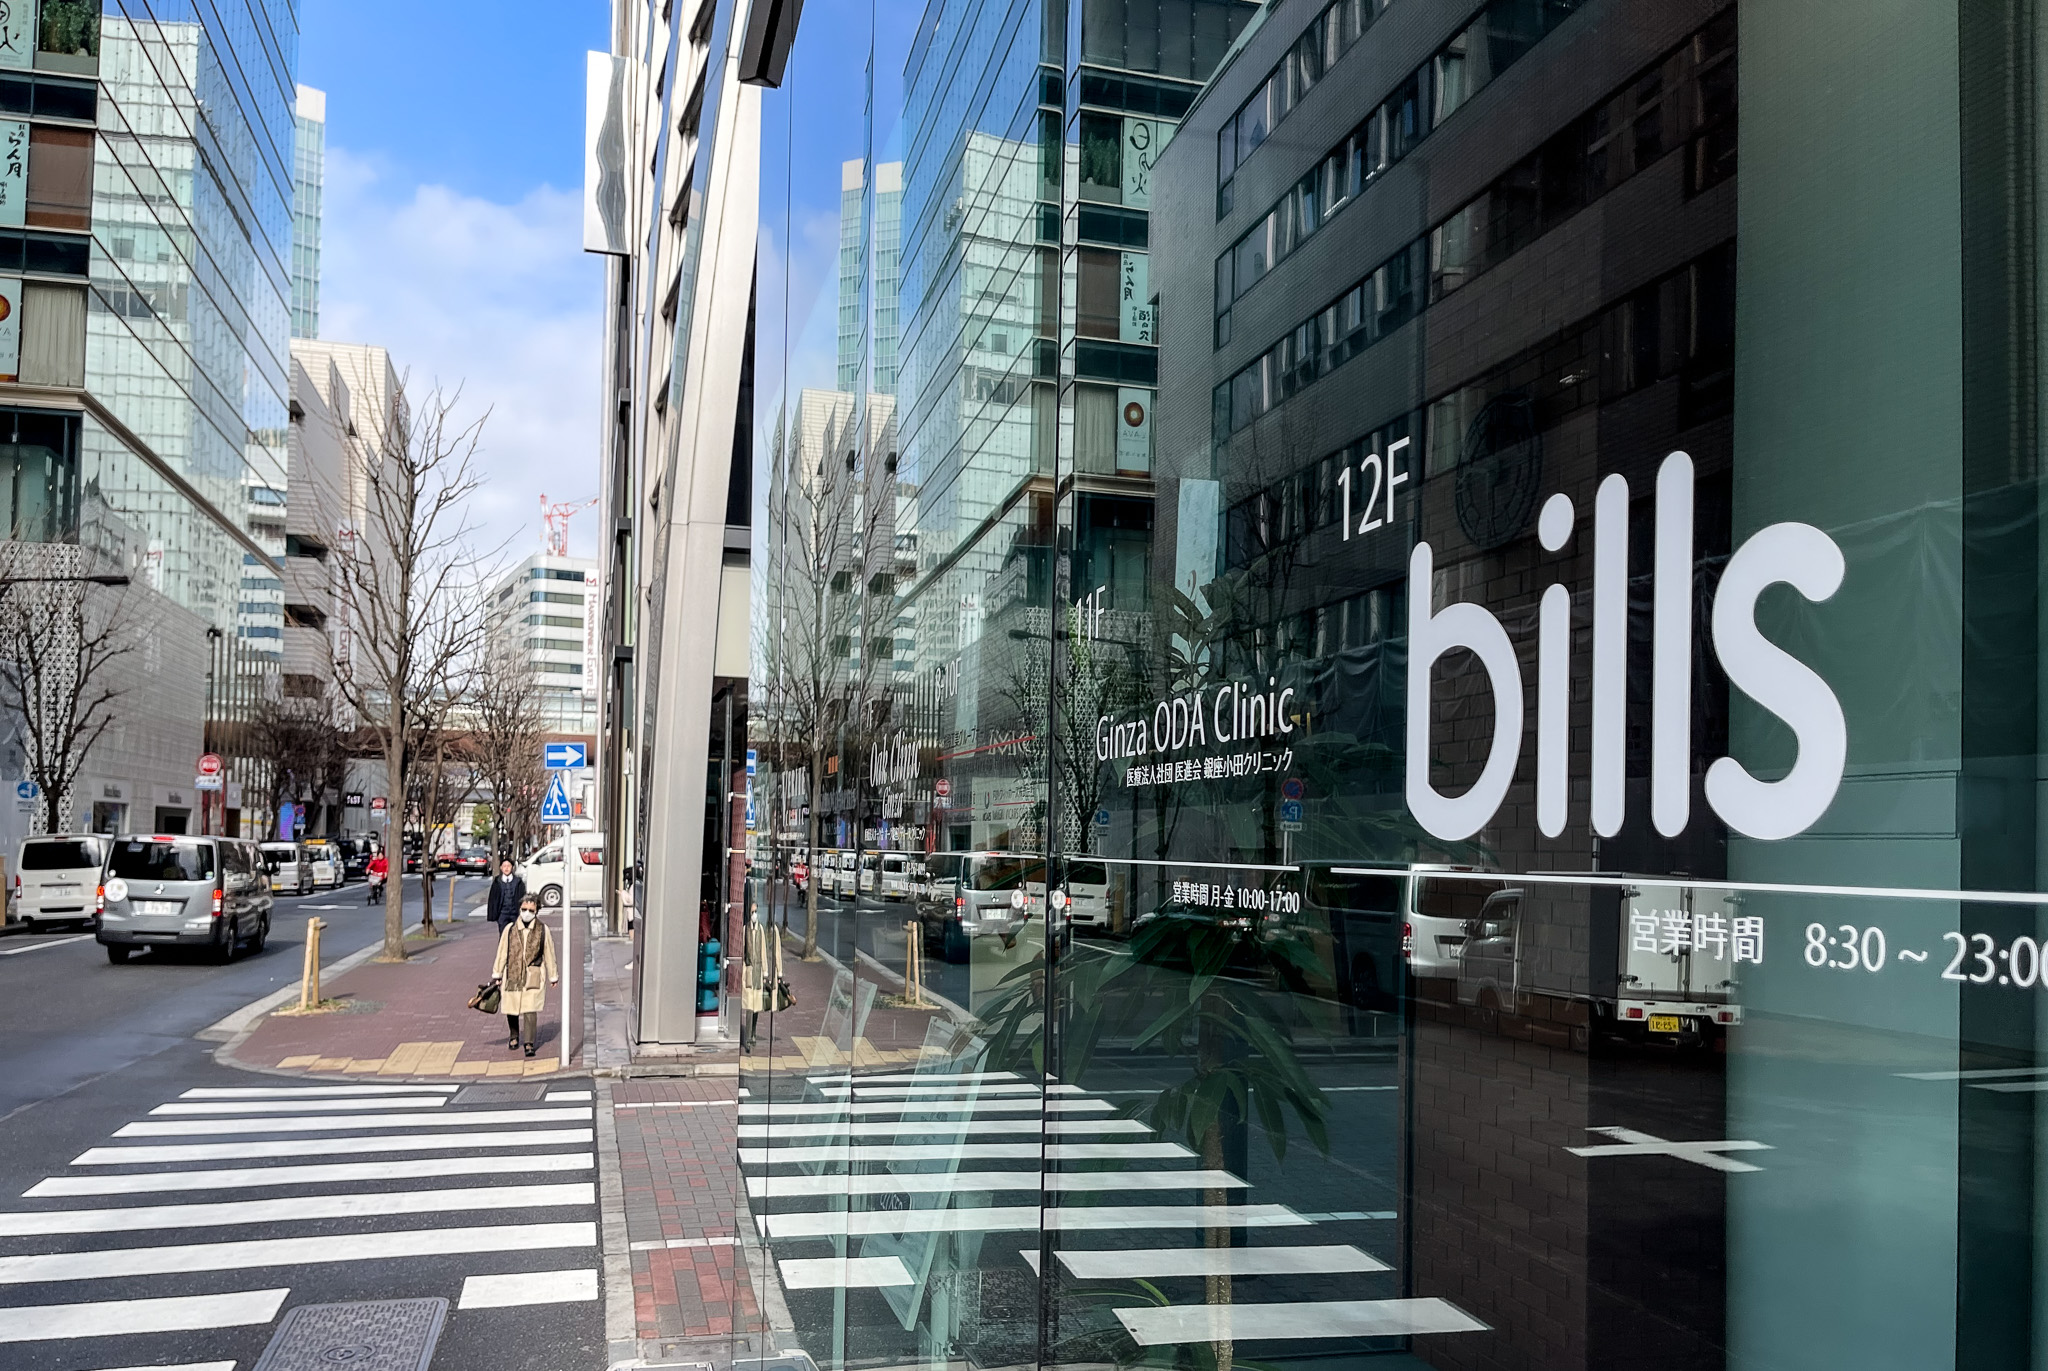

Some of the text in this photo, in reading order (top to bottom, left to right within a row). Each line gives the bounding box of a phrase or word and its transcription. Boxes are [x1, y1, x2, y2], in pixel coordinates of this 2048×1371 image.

[1337, 436, 1411, 542] 12F
[1075, 585, 1106, 646] 11F
[1405, 450, 1848, 841] bills
[935, 657, 961, 702] 8-10F
[1096, 676, 1294, 761] Ginza ODA Clinic
[869, 727, 922, 788] Oak Clinic
[1126, 747, 1293, 788] 医療法人社団 医進会 銀座小田クリニック
[1172, 881, 1209, 907] 営業時間
[1237, 887, 1300, 915] 10:00-17:00
[1630, 908, 1765, 965] 営業時間
[1803, 922, 1887, 973] 8:30
